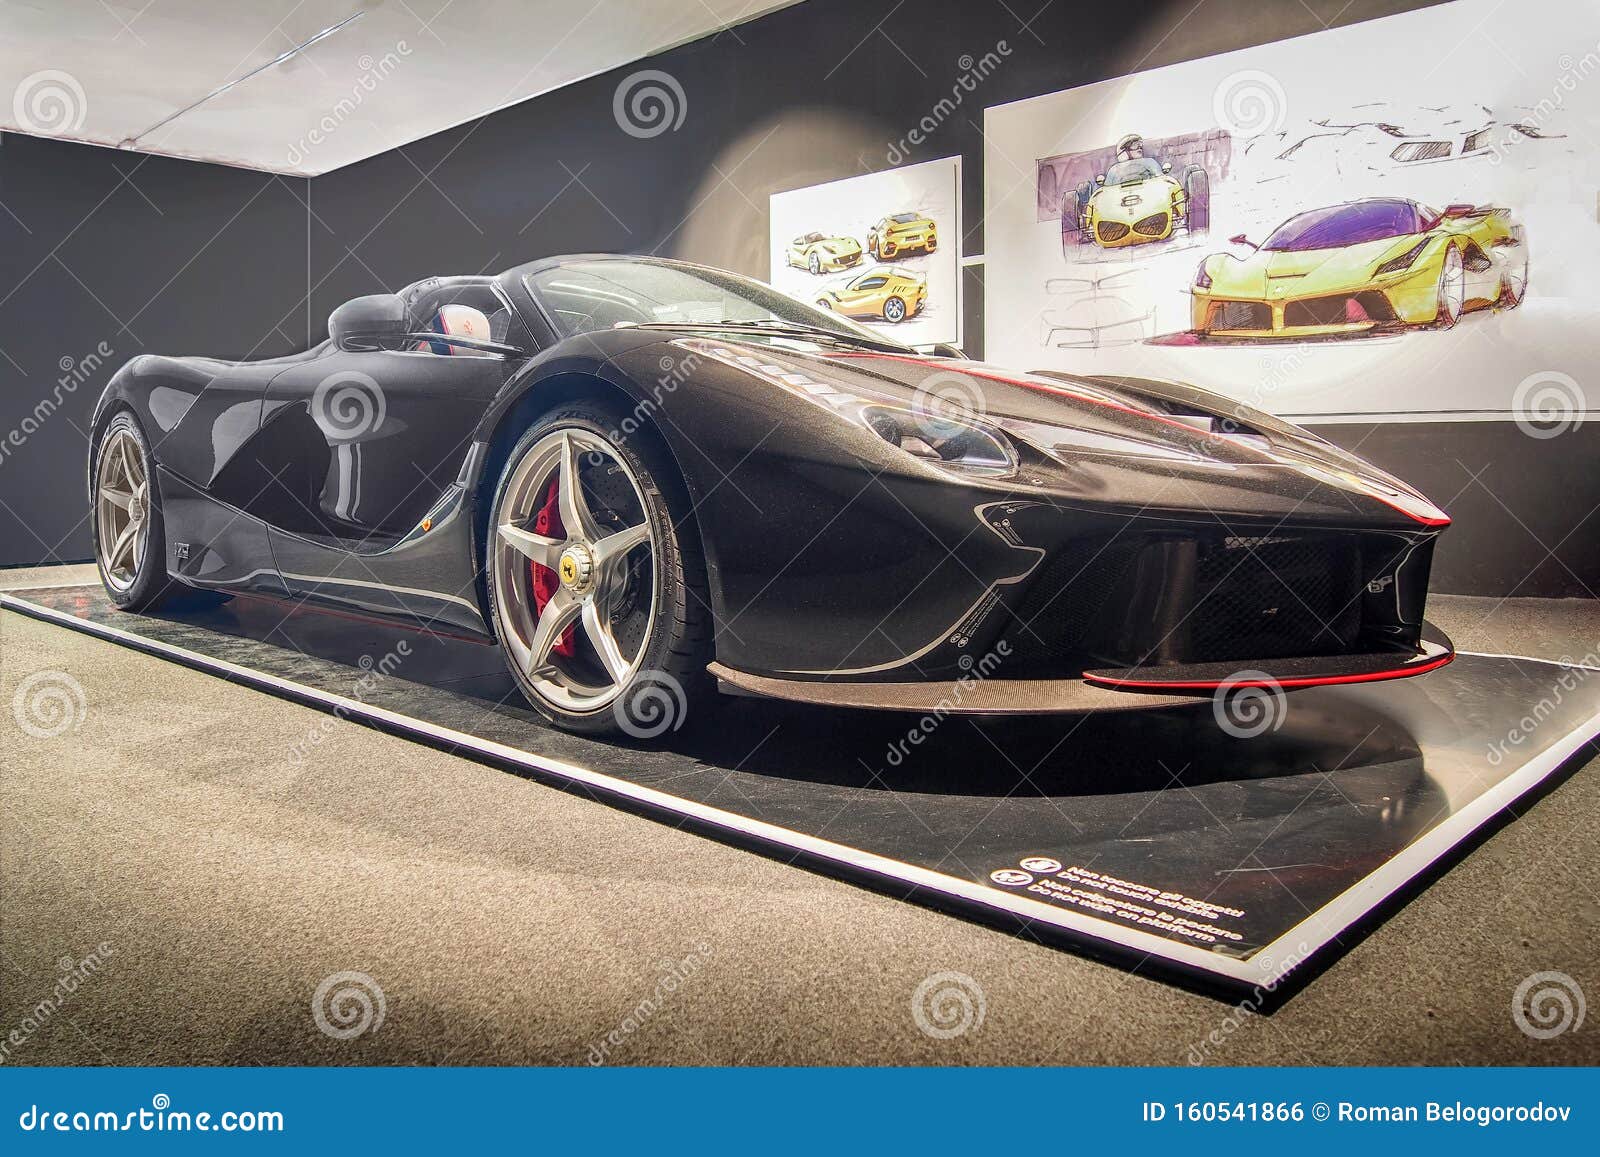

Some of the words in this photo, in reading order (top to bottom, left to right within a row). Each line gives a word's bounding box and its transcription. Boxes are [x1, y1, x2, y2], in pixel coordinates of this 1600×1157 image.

[1039, 879, 1072, 893] Non
[1056, 871, 1081, 882] Do
[1080, 878, 1108, 890] not
[1107, 884, 1154, 902] touch
[1067, 866, 1100, 880] Non
[1100, 875, 1160, 896] toccare
[1027, 884, 1051, 895] Do
[1050, 891, 1080, 904] not
[1079, 899, 1117, 914] walk
[1116, 910, 1140, 921] on
[1137, 916, 1216, 942] platform
